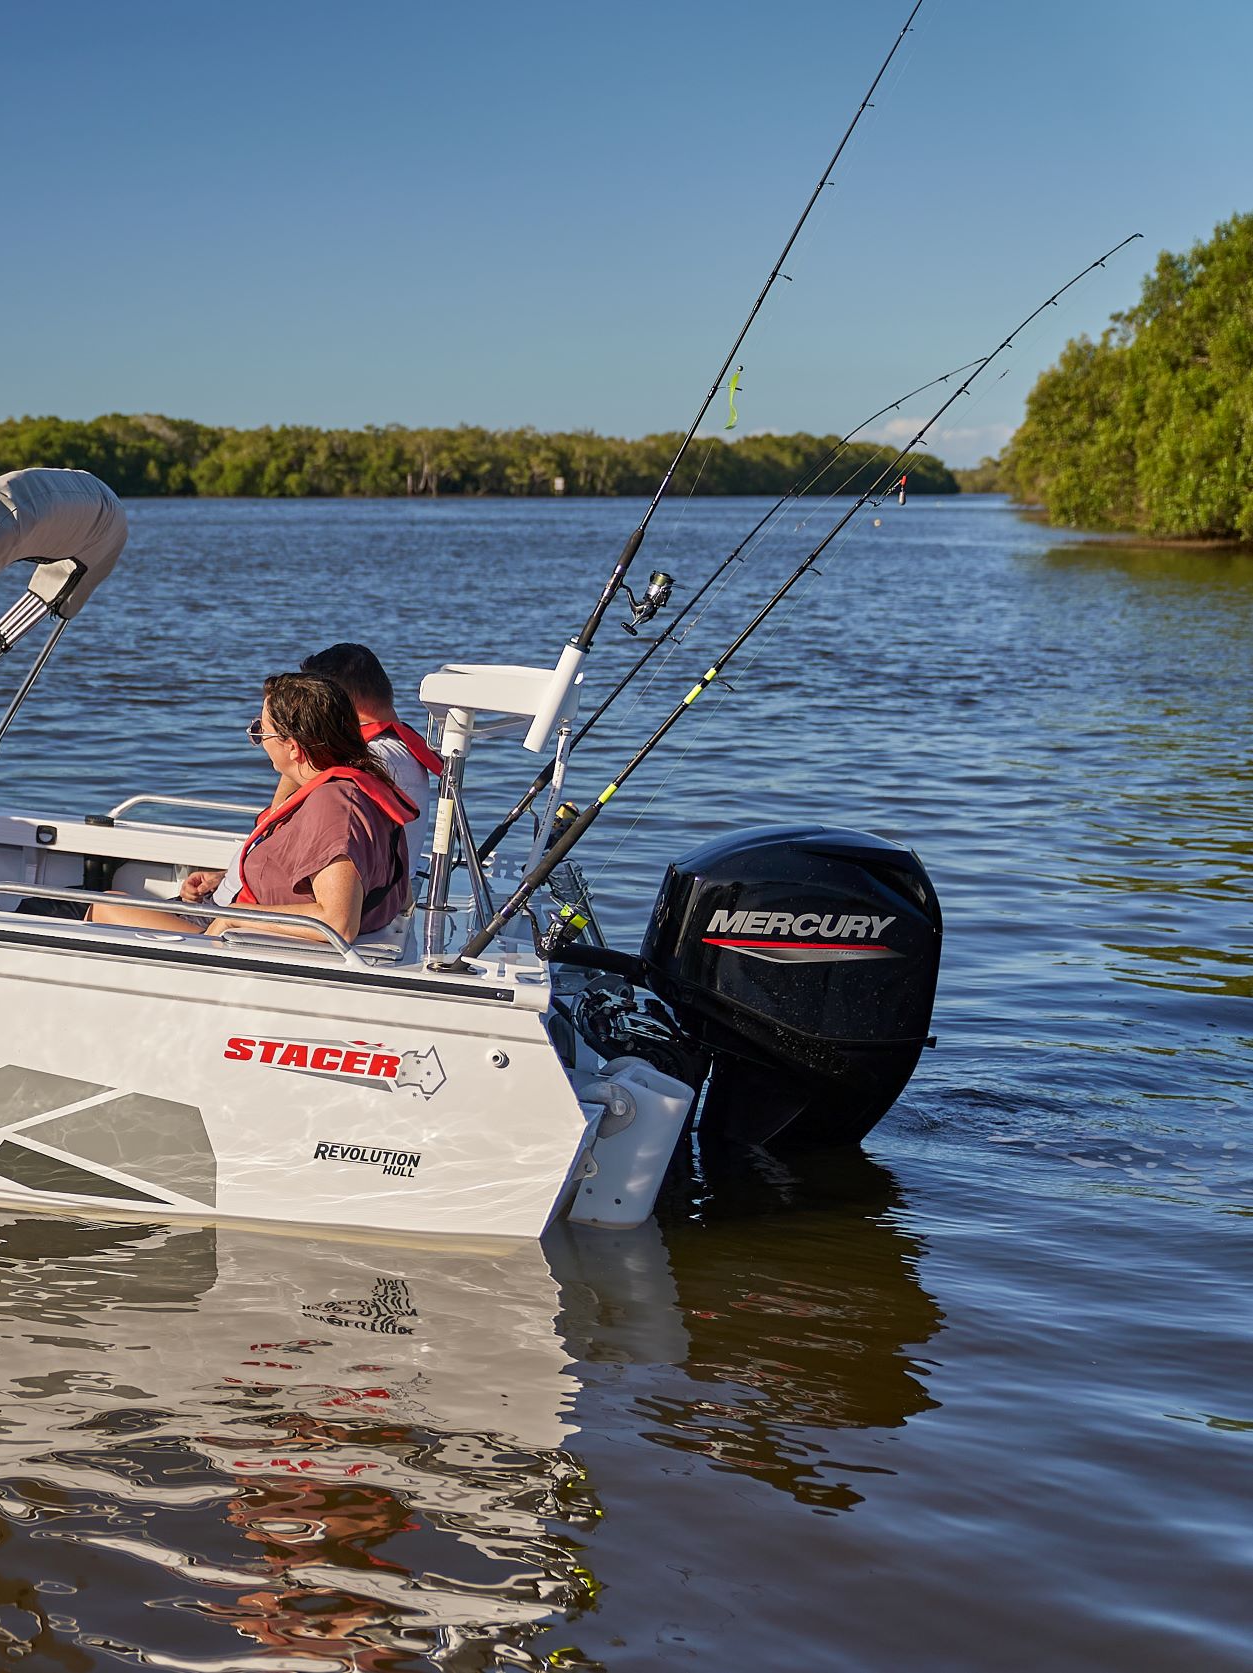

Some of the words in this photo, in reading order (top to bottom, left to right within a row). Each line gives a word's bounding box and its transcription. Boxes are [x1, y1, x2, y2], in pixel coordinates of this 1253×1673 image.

[706, 909, 897, 939] MERCURY
[224, 1037, 401, 1078] STACER
[314, 1143, 421, 1168] REVOLUTION
[382, 1166, 414, 1177] HULL
